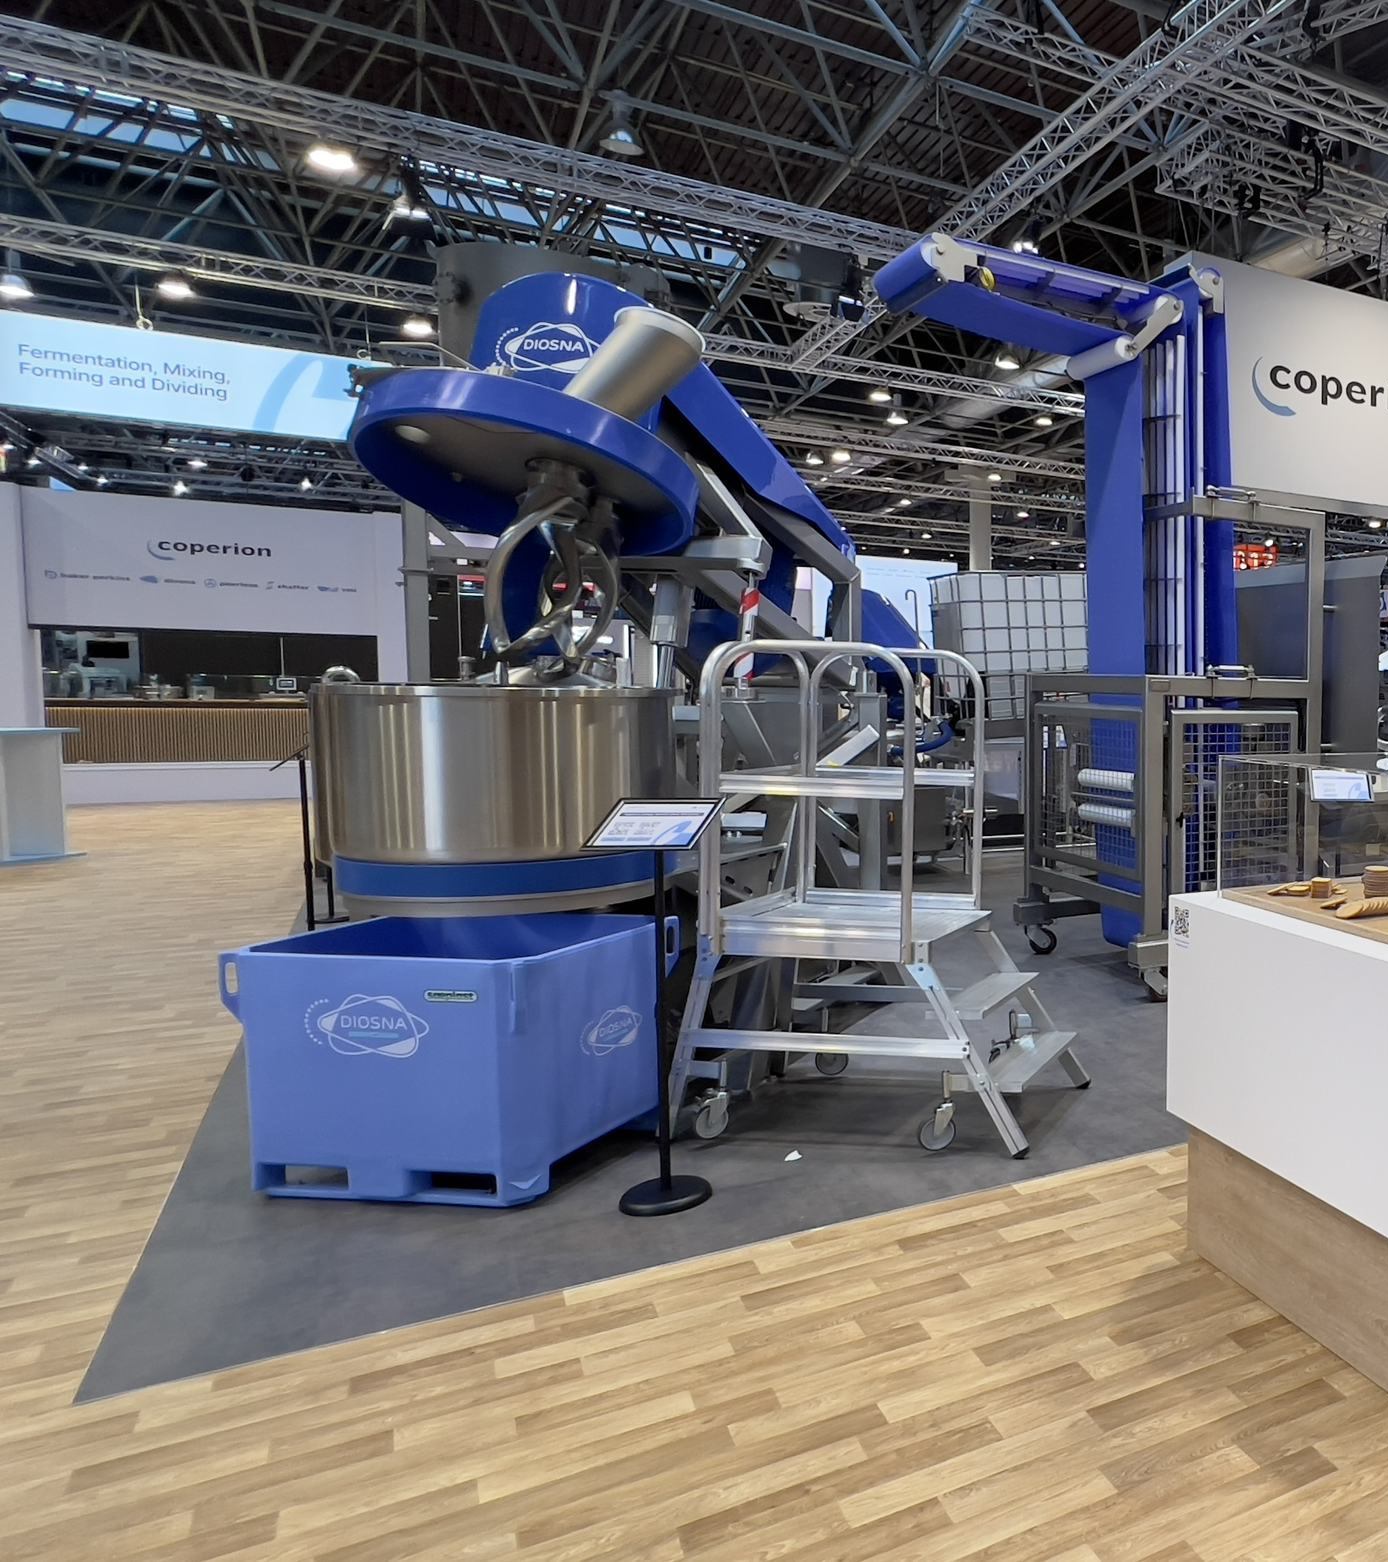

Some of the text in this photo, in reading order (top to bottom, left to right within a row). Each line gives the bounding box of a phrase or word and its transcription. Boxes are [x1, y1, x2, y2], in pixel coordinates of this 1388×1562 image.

[523, 339, 585, 353] DIOSNA
[18, 343, 231, 384] Fermentation, Mixing,
[19, 361, 228, 401] Forming and Dividing
[157, 541, 272, 557] coperion
[340, 1015, 408, 1031] DIOSNA
[599, 1017, 633, 1038] DIOSNA
